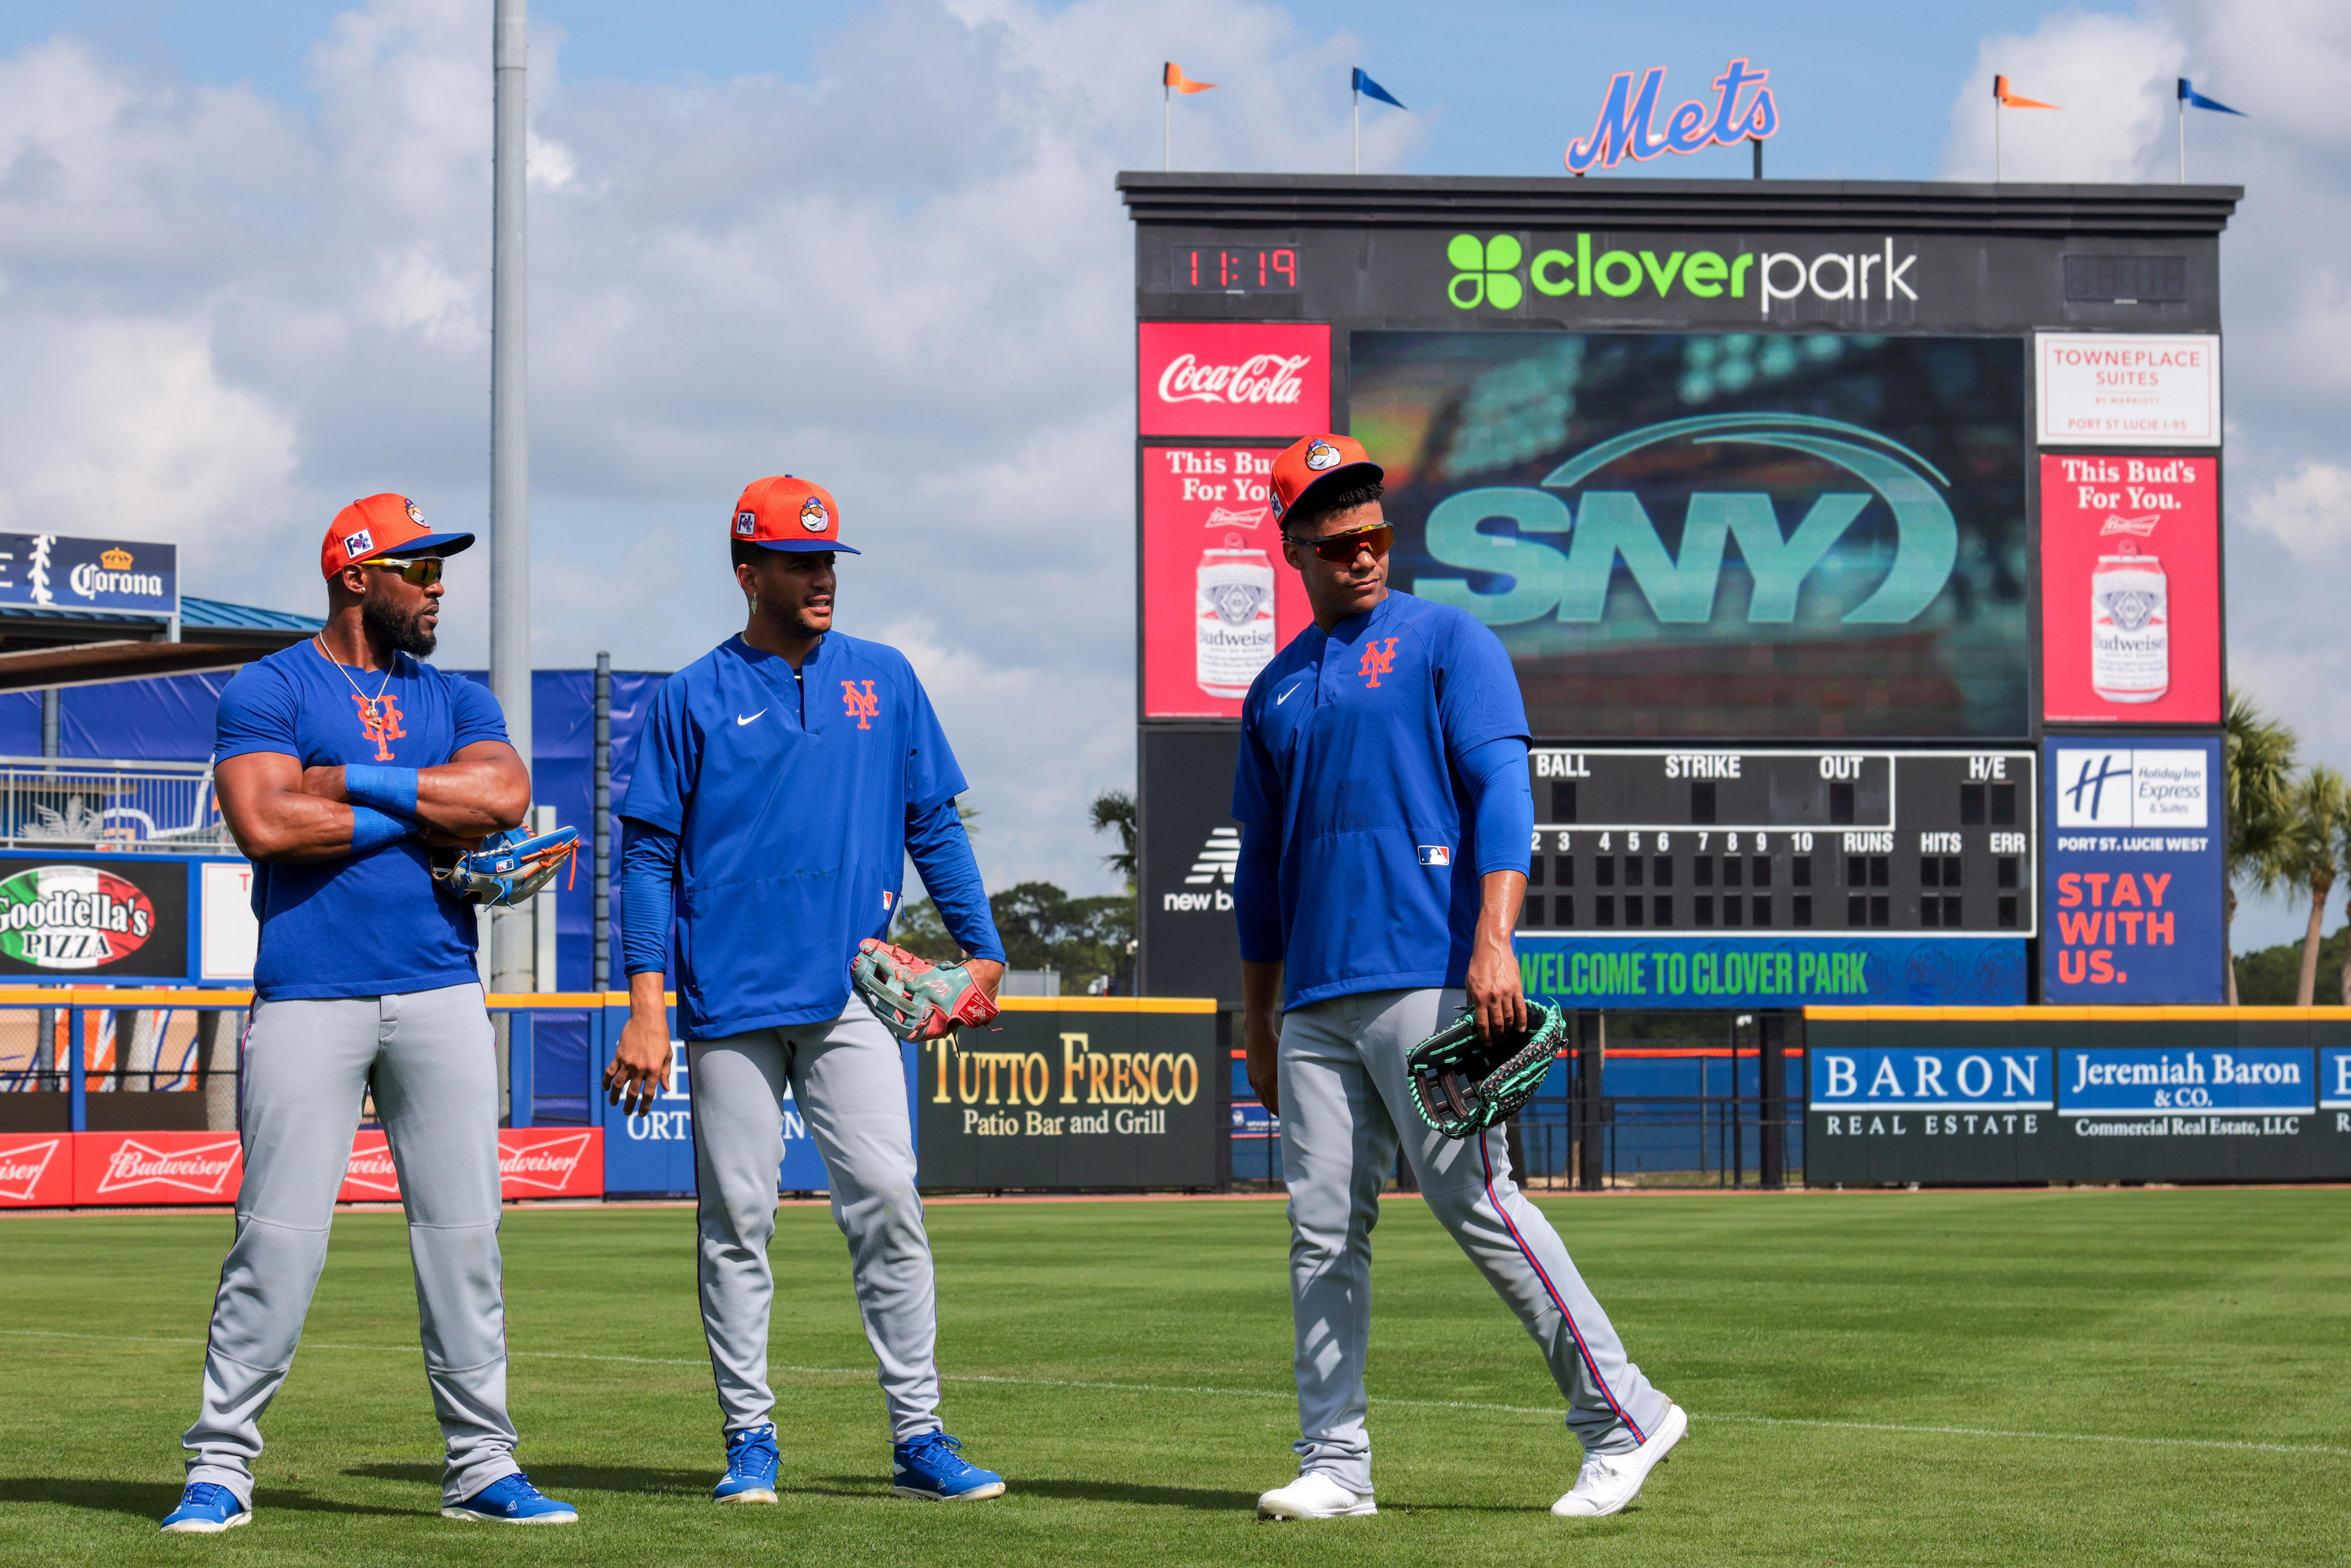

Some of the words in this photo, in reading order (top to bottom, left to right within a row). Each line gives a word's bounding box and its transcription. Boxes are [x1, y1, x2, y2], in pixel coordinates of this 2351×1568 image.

[1565, 57, 1779, 173] Mets
[1191, 249, 1296, 287] 11:19
[2054, 349, 2201, 367] TOWNEPLACE
[1158, 353, 1311, 404] Coca-Cola
[2096, 371, 2159, 386] SUITES
[2069, 419, 2101, 429] PORT
[2106, 419, 2120, 429] ST
[2124, 419, 2159, 430] LUCIE
[1166, 451, 1227, 475] This
[2061, 459, 2120, 483] This
[2126, 459, 2196, 483] Bud's
[1182, 479, 1227, 501] For
[1233, 479, 1270, 501] Yo
[2078, 486, 2121, 509] For
[2126, 487, 2182, 510] You.
[1414, 485, 1873, 626] SNY
[70, 562, 163, 601] Corona
[1536, 754, 1591, 777] BALL
[1665, 755, 1741, 779] STRIKE
[1819, 755, 1864, 779] OUT
[1969, 756, 2006, 781] H/E
[2139, 767, 2182, 781] Holiday
[2183, 770, 2201, 779] Inn
[2139, 781, 2201, 801] Express
[2159, 802, 2189, 814] Suites
[1532, 831, 1541, 851] 2
[1558, 831, 1570, 851] 3
[1599, 831, 1611, 851] 4
[1628, 831, 1641, 851] 5
[1657, 831, 1670, 851] 6
[1698, 831, 1709, 851] 7
[1727, 831, 1738, 851] 8
[1756, 831, 1767, 851] 9
[1791, 831, 1813, 851] 10
[1843, 832, 1894, 852] RUNS
[1921, 832, 1962, 852] HITS
[1990, 832, 2026, 853] ERR
[2058, 837, 2097, 851] PORT
[2098, 837, 2122, 851] ST.
[2124, 837, 2164, 851] LUCIE
[2165, 837, 2208, 851] WEST
[1163, 893, 1212, 911] new
[2058, 873, 2172, 907] STAY
[2058, 912, 2174, 945] WITH
[25, 934, 111, 959] PIZZA
[1516, 952, 1646, 994] WELCOME
[1652, 952, 1687, 994] TO
[1692, 952, 1793, 994] CLOVER
[1799, 952, 1868, 994] PARK
[2059, 950, 2127, 984] US.
[930, 978, 953, 997] 100
[926, 1032, 1049, 1105] TUTTO
[1059, 1032, 1199, 1105] FRESCO
[1825, 1055, 2039, 1097] BARON
[2072, 1051, 2206, 1093] Jeremiah
[2212, 1053, 2301, 1084] Baron
[2154, 1089, 2172, 1107] &
[2174, 1087, 2213, 1107] CO.
[963, 1109, 1019, 1136] Patio
[1025, 1111, 1065, 1135] Bar
[1070, 1109, 1110, 1134] and
[1115, 1109, 1167, 1135] Grill
[1827, 1115, 1907, 1135] REAL
[1925, 1114, 2039, 1135] ESTATE
[2075, 1117, 2169, 1136] Commercial
[2172, 1117, 2206, 1135] Real
[2210, 1117, 2260, 1137] Estate,
[2263, 1117, 2300, 1135] LLC
[110, 1151, 230, 1178] Budweiser
[499, 1150, 577, 1173] udweiser
